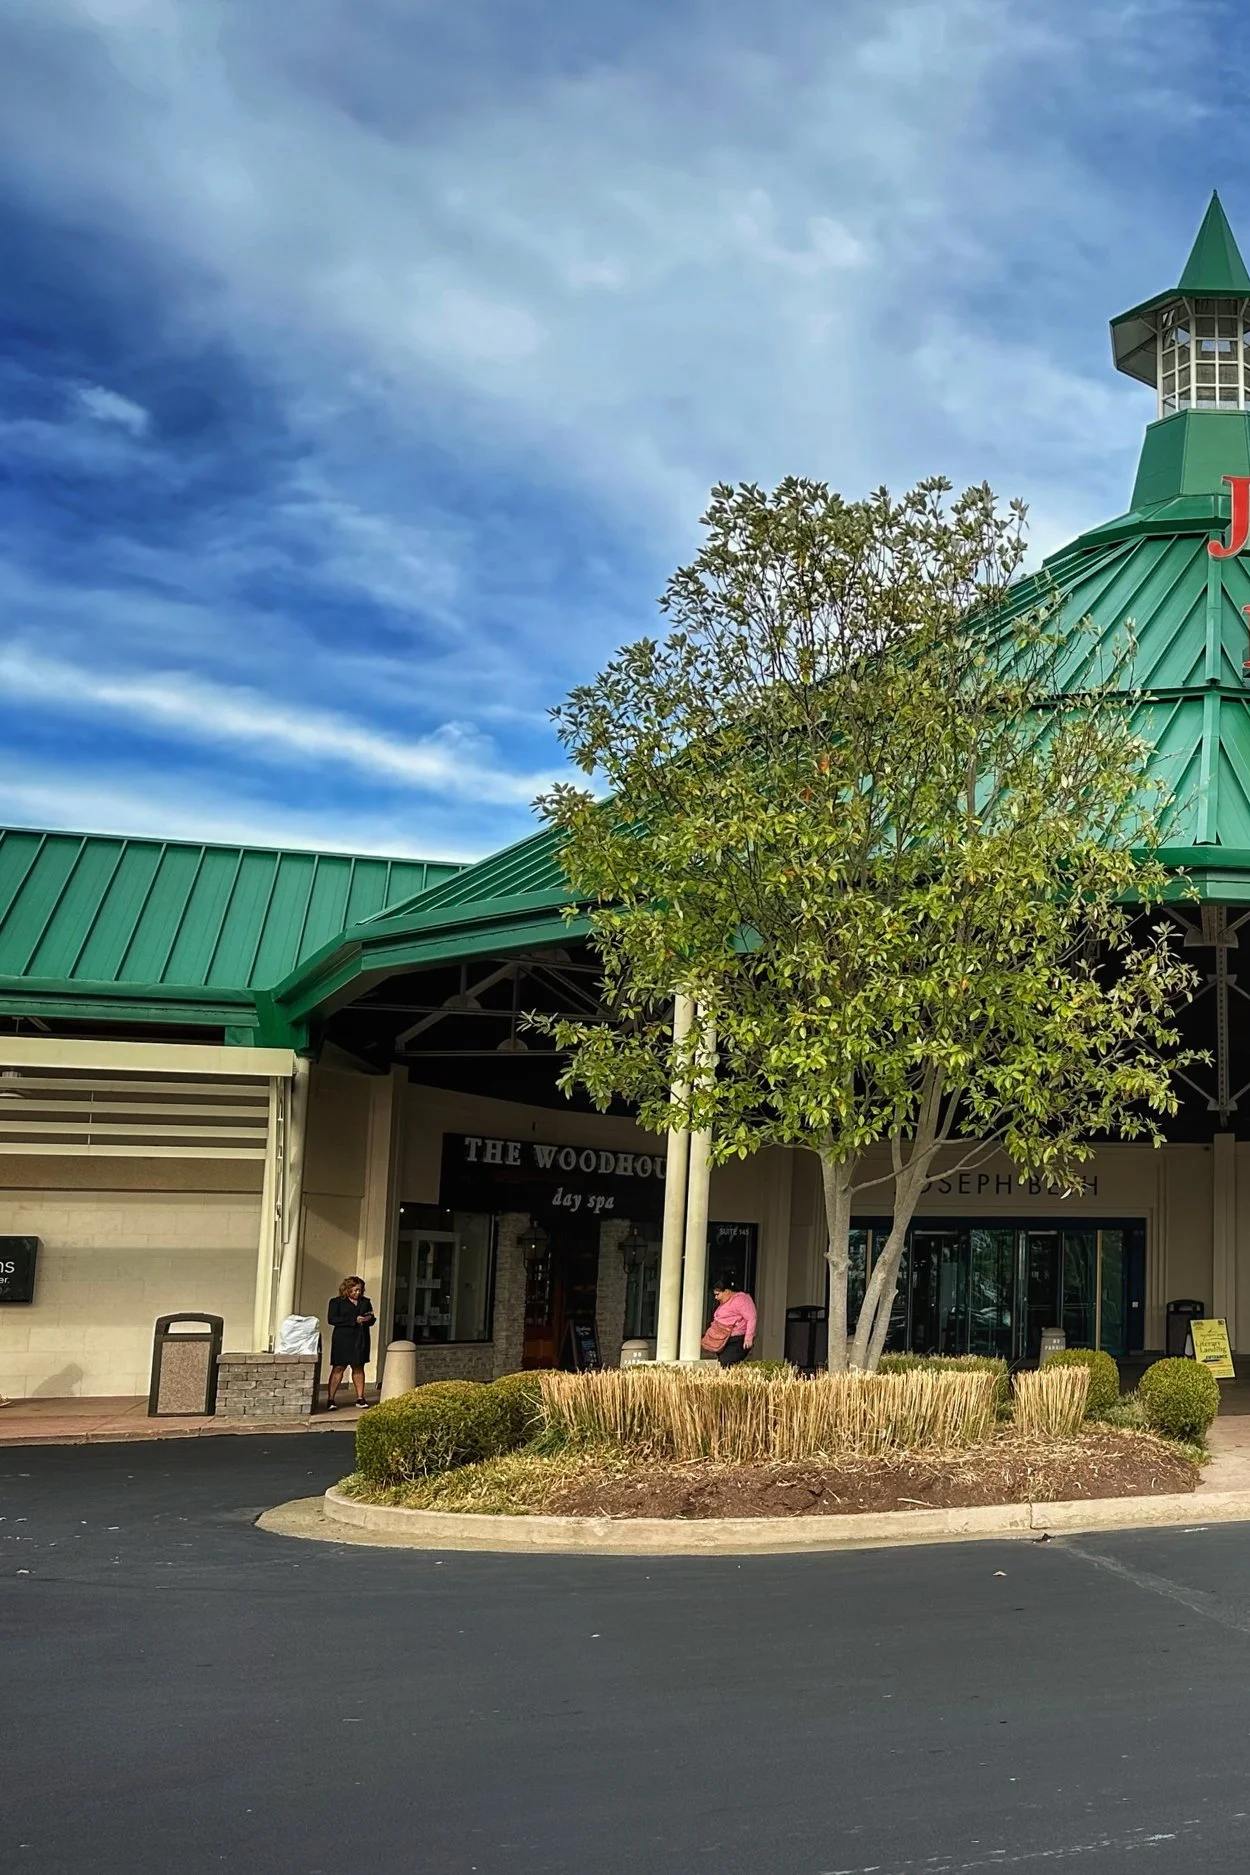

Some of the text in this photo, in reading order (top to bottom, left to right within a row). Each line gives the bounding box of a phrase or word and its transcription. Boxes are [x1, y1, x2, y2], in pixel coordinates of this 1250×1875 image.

[465, 1137, 521, 1166] THE
[552, 1187, 615, 1214] day spa
[719, 1227, 738, 1236] SUITE
